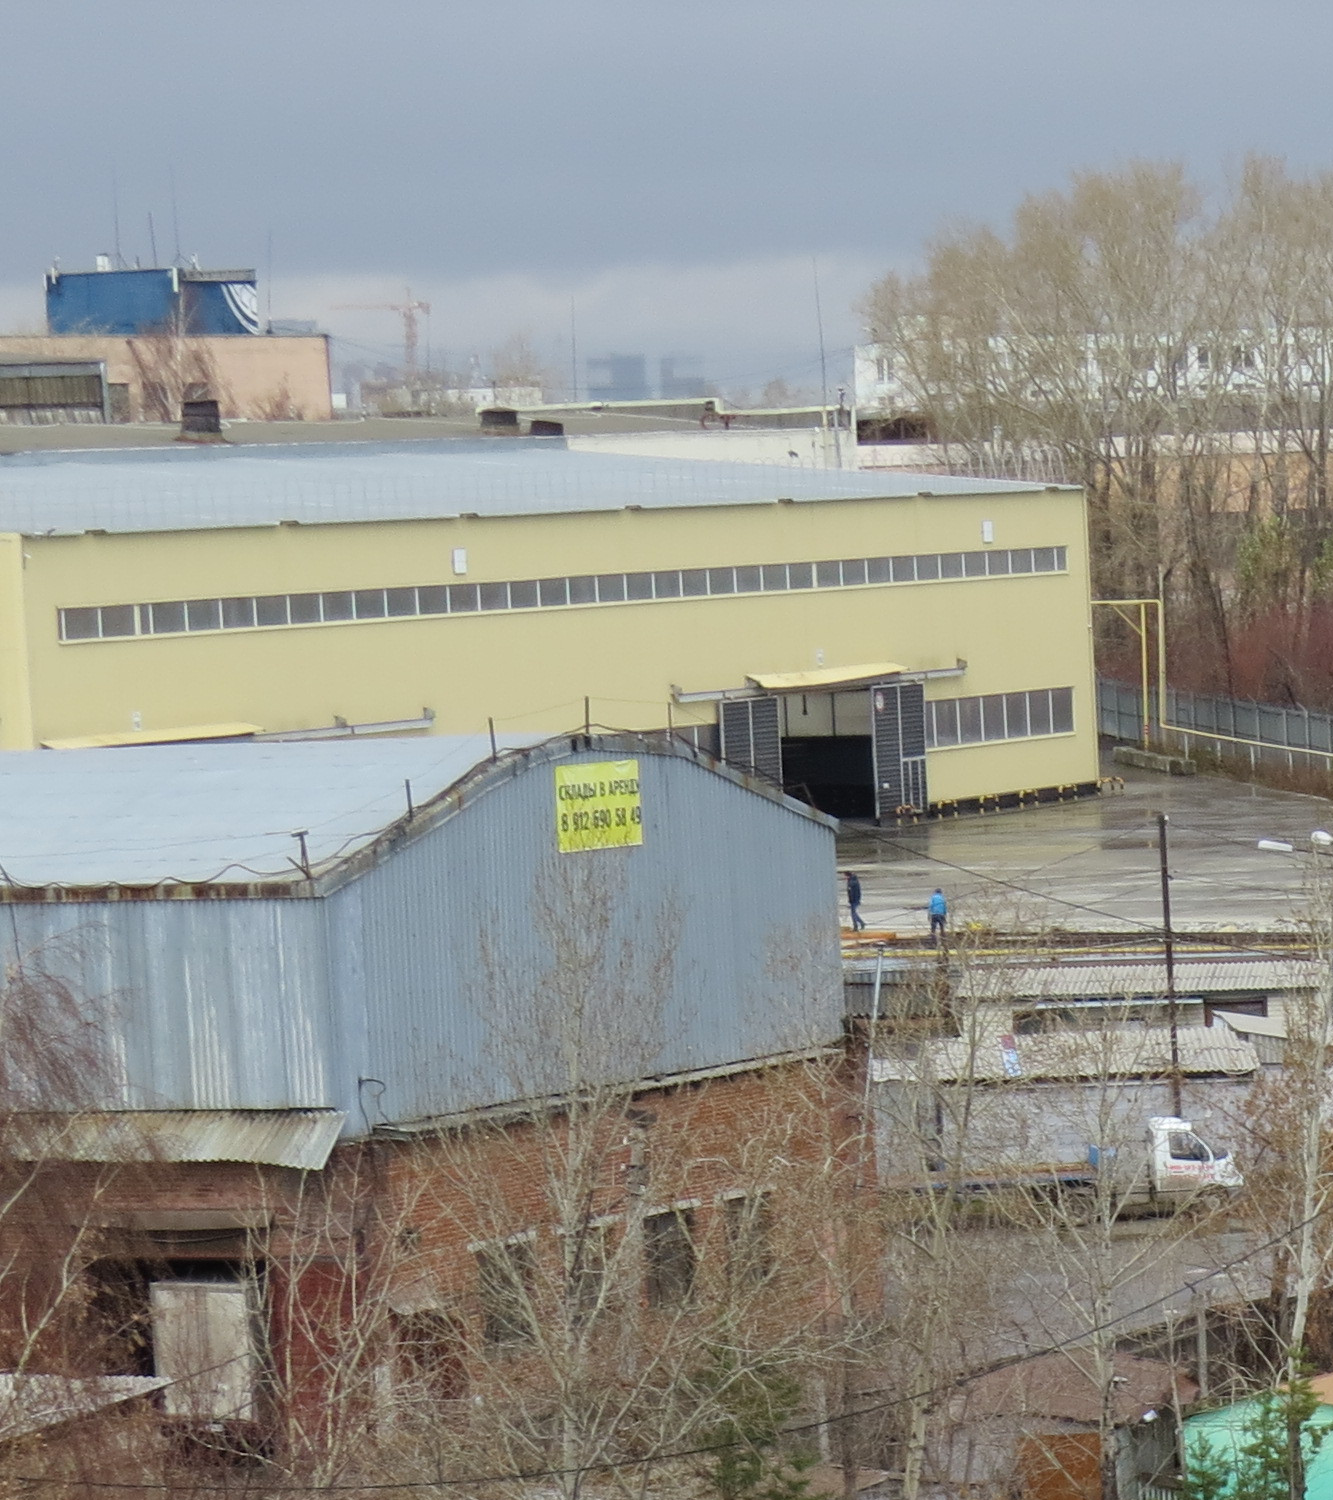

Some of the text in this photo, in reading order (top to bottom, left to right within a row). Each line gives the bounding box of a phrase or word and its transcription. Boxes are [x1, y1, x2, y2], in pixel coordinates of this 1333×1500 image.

[559, 783, 597, 801] СКЛАДЫ
[599, 782, 606, 797] В
[561, 812, 569, 833] 8
[573, 810, 590, 832] 912
